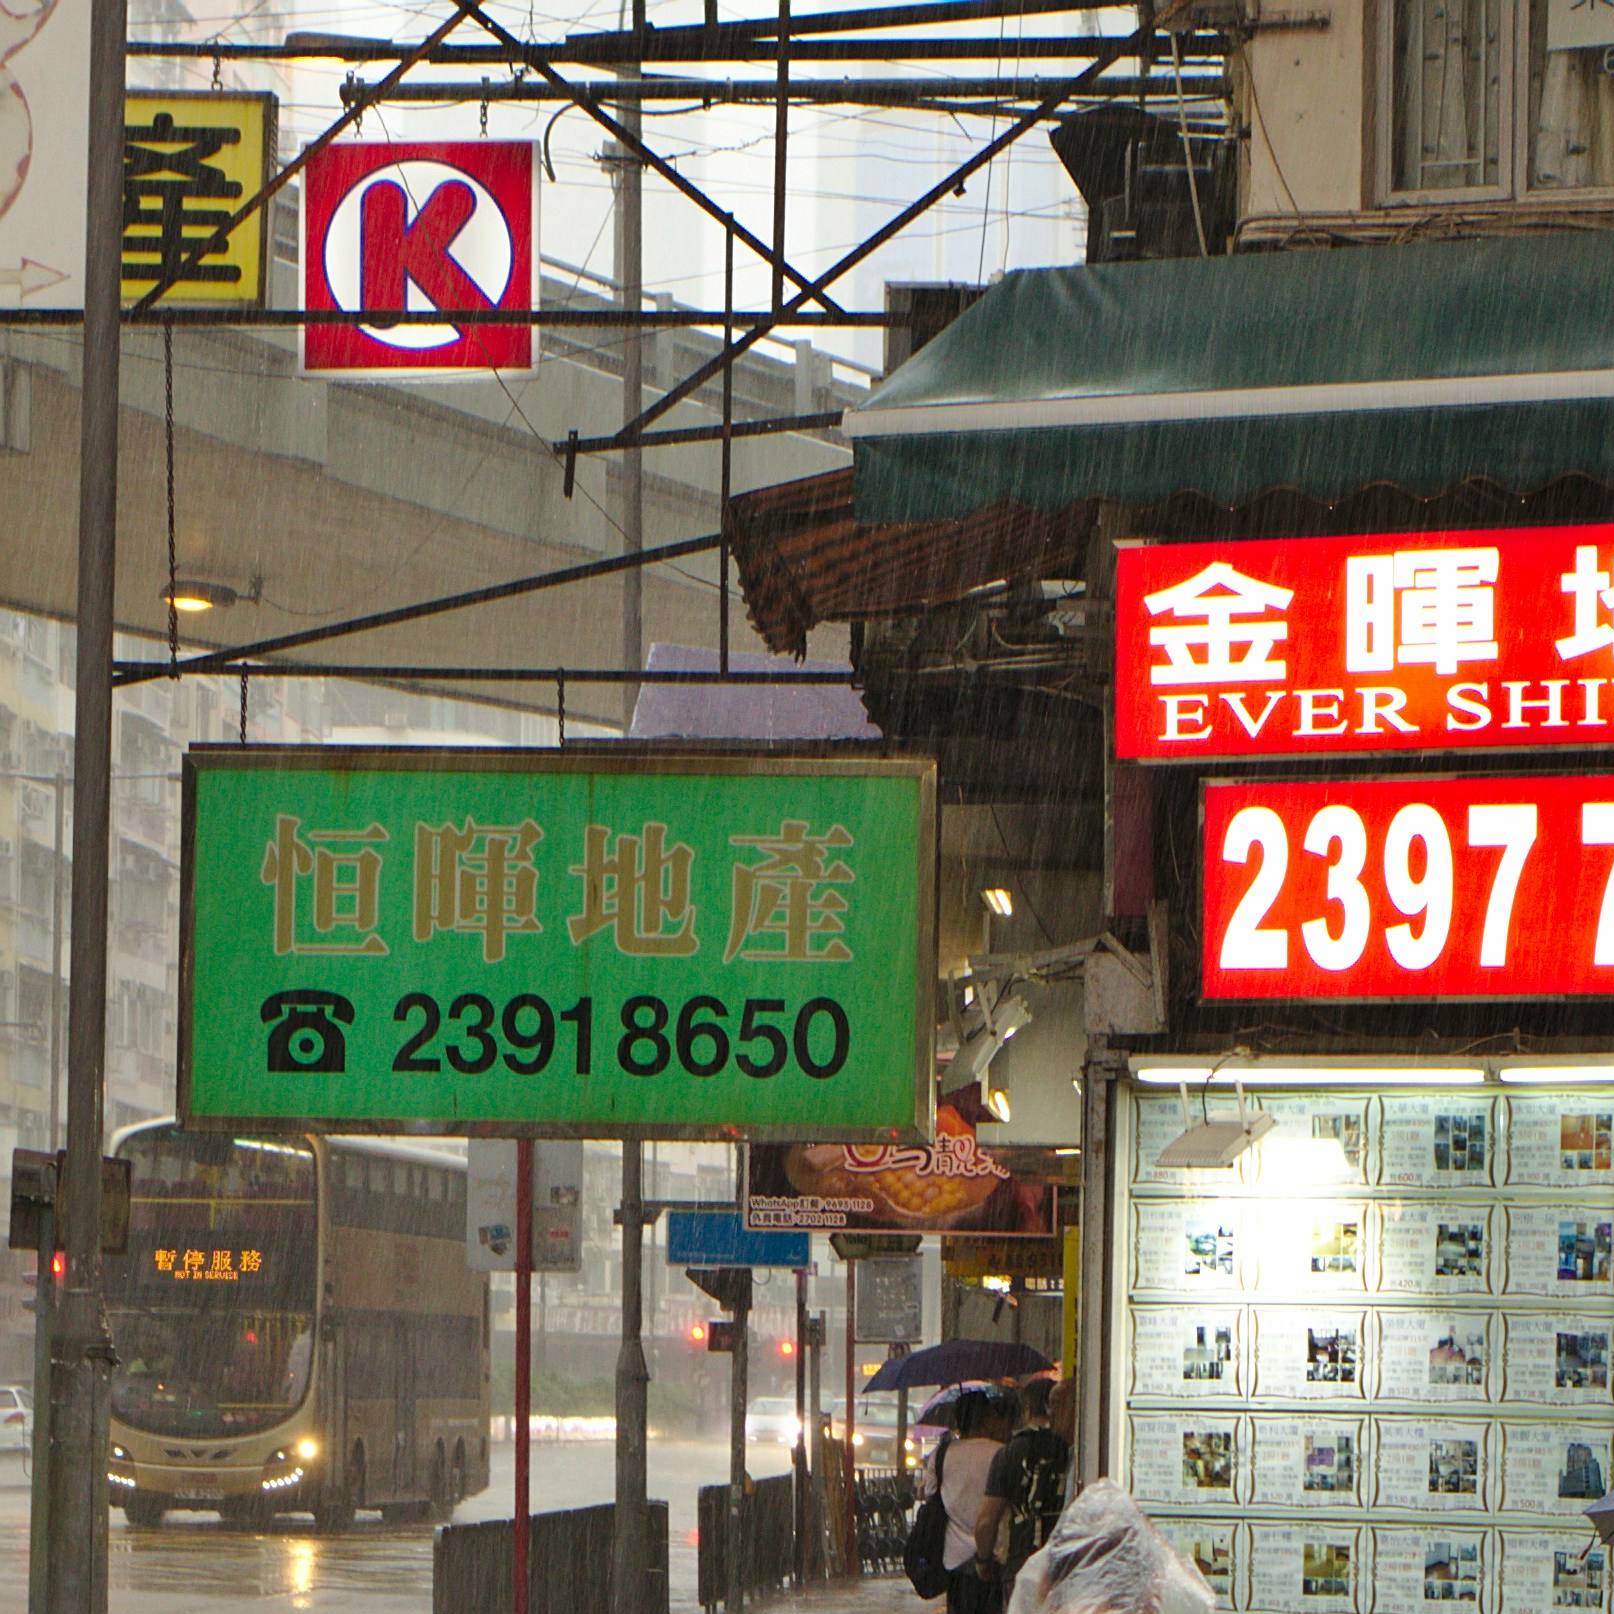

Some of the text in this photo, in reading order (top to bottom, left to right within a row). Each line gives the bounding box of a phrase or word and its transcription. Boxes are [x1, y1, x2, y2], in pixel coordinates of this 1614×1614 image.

[1158, 685, 1418, 743] EVER
[1218, 803, 1540, 972] 2397
[154, 1248, 263, 1272] 暫停服務
